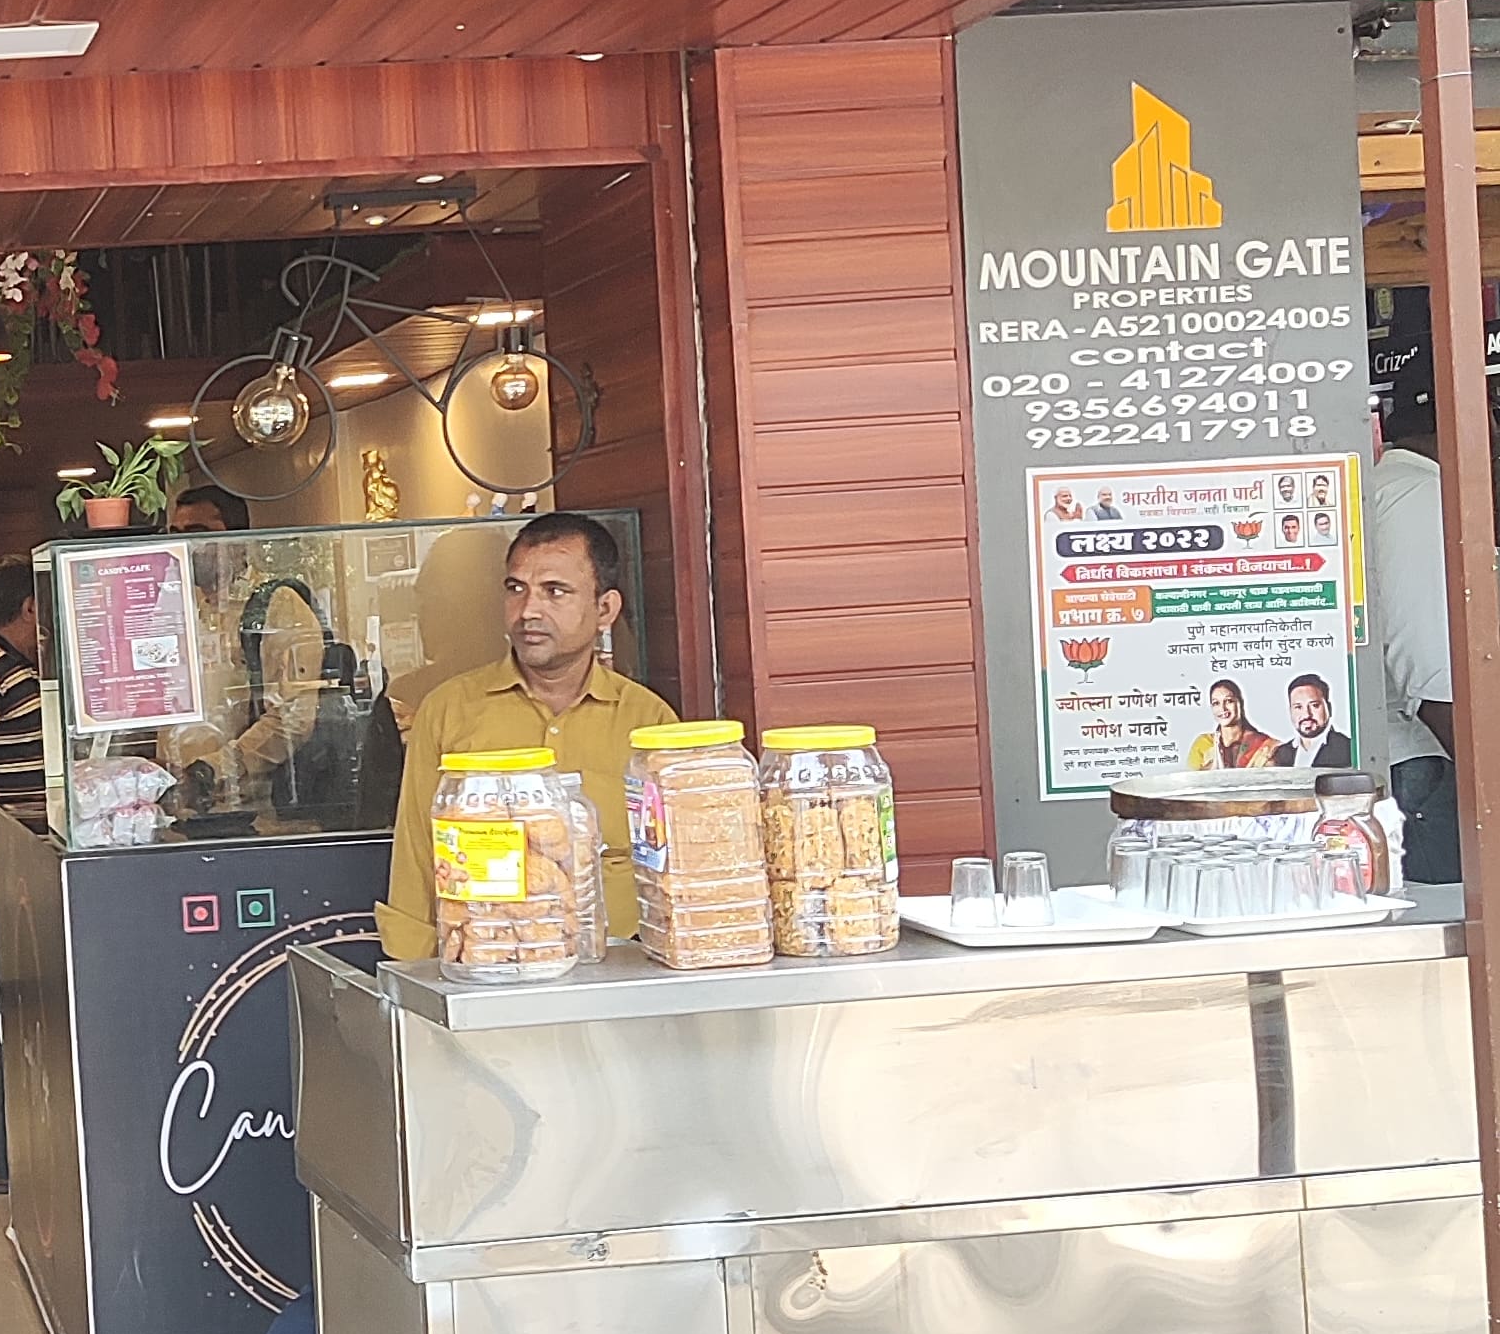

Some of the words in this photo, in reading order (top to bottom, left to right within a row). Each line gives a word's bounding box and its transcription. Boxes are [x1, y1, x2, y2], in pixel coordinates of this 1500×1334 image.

[978, 243, 1221, 291] MOUNTAIN
[1236, 236, 1351, 279] GATE
[1072, 283, 1253, 310] PROPERTIES
[1069, 335, 1267, 367] contact
[982, 373, 1070, 398] 020
[1119, 359, 1354, 392] 41274009
[1024, 388, 1309, 423] 9356694011
[1026, 414, 1317, 450] 9822417918
[1122, 485, 1179, 506] भारतीय
[1183, 488, 1227, 503] जनता
[1233, 479, 1265, 501] पार्टी
[1069, 532, 1134, 553] लक्ष्य
[1142, 528, 1210, 550] २०२२
[1058, 609, 1102, 625] प्रभाग
[1131, 607, 1144, 621] ७
[1187, 622, 1205, 640] पुणे
[1209, 640, 1238, 652] प्रभाग
[1307, 633, 1335, 648] करणे
[1210, 656, 1228, 671] हेच
[1118, 689, 1157, 708] गणेश
[1163, 686, 1201, 706] गवारे
[1081, 718, 1122, 738] गणेश
[1128, 716, 1168, 736] गवारे
